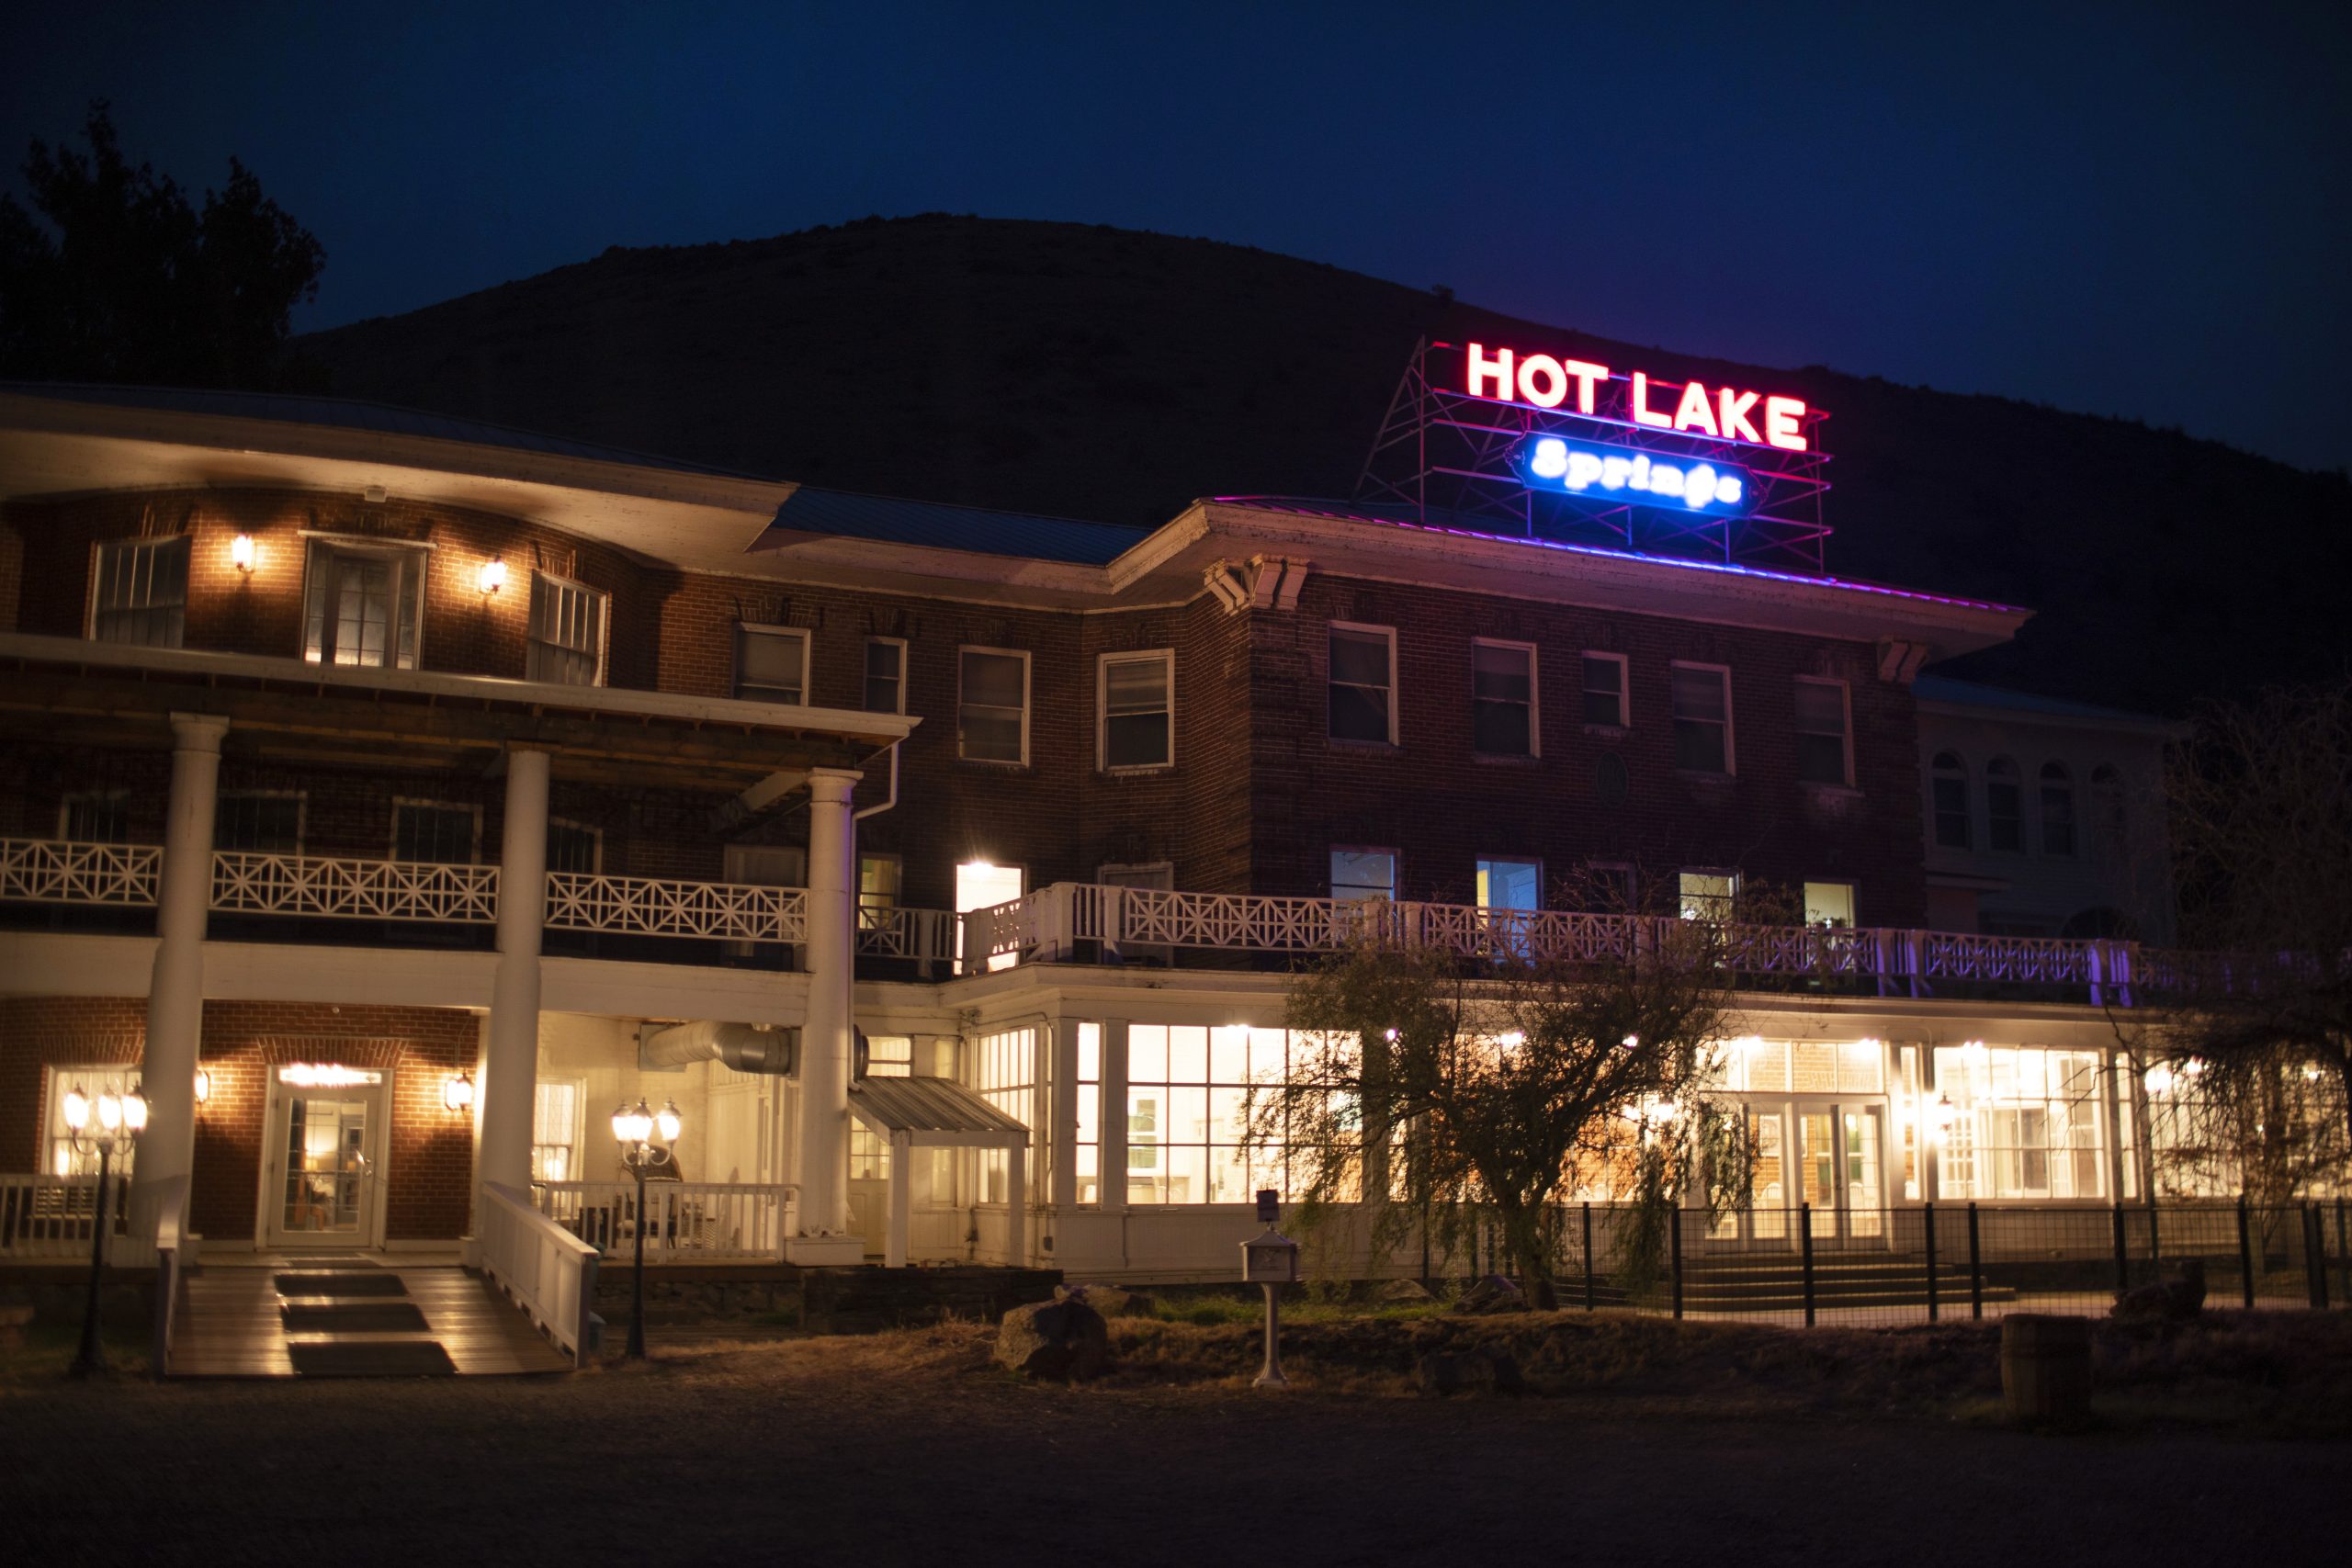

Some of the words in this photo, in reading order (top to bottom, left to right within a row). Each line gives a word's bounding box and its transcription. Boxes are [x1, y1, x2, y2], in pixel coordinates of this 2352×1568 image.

[1468, 343, 1609, 415] HOT
[1633, 372, 1807, 451] LAKE
[1532, 438, 1742, 509] Springs
